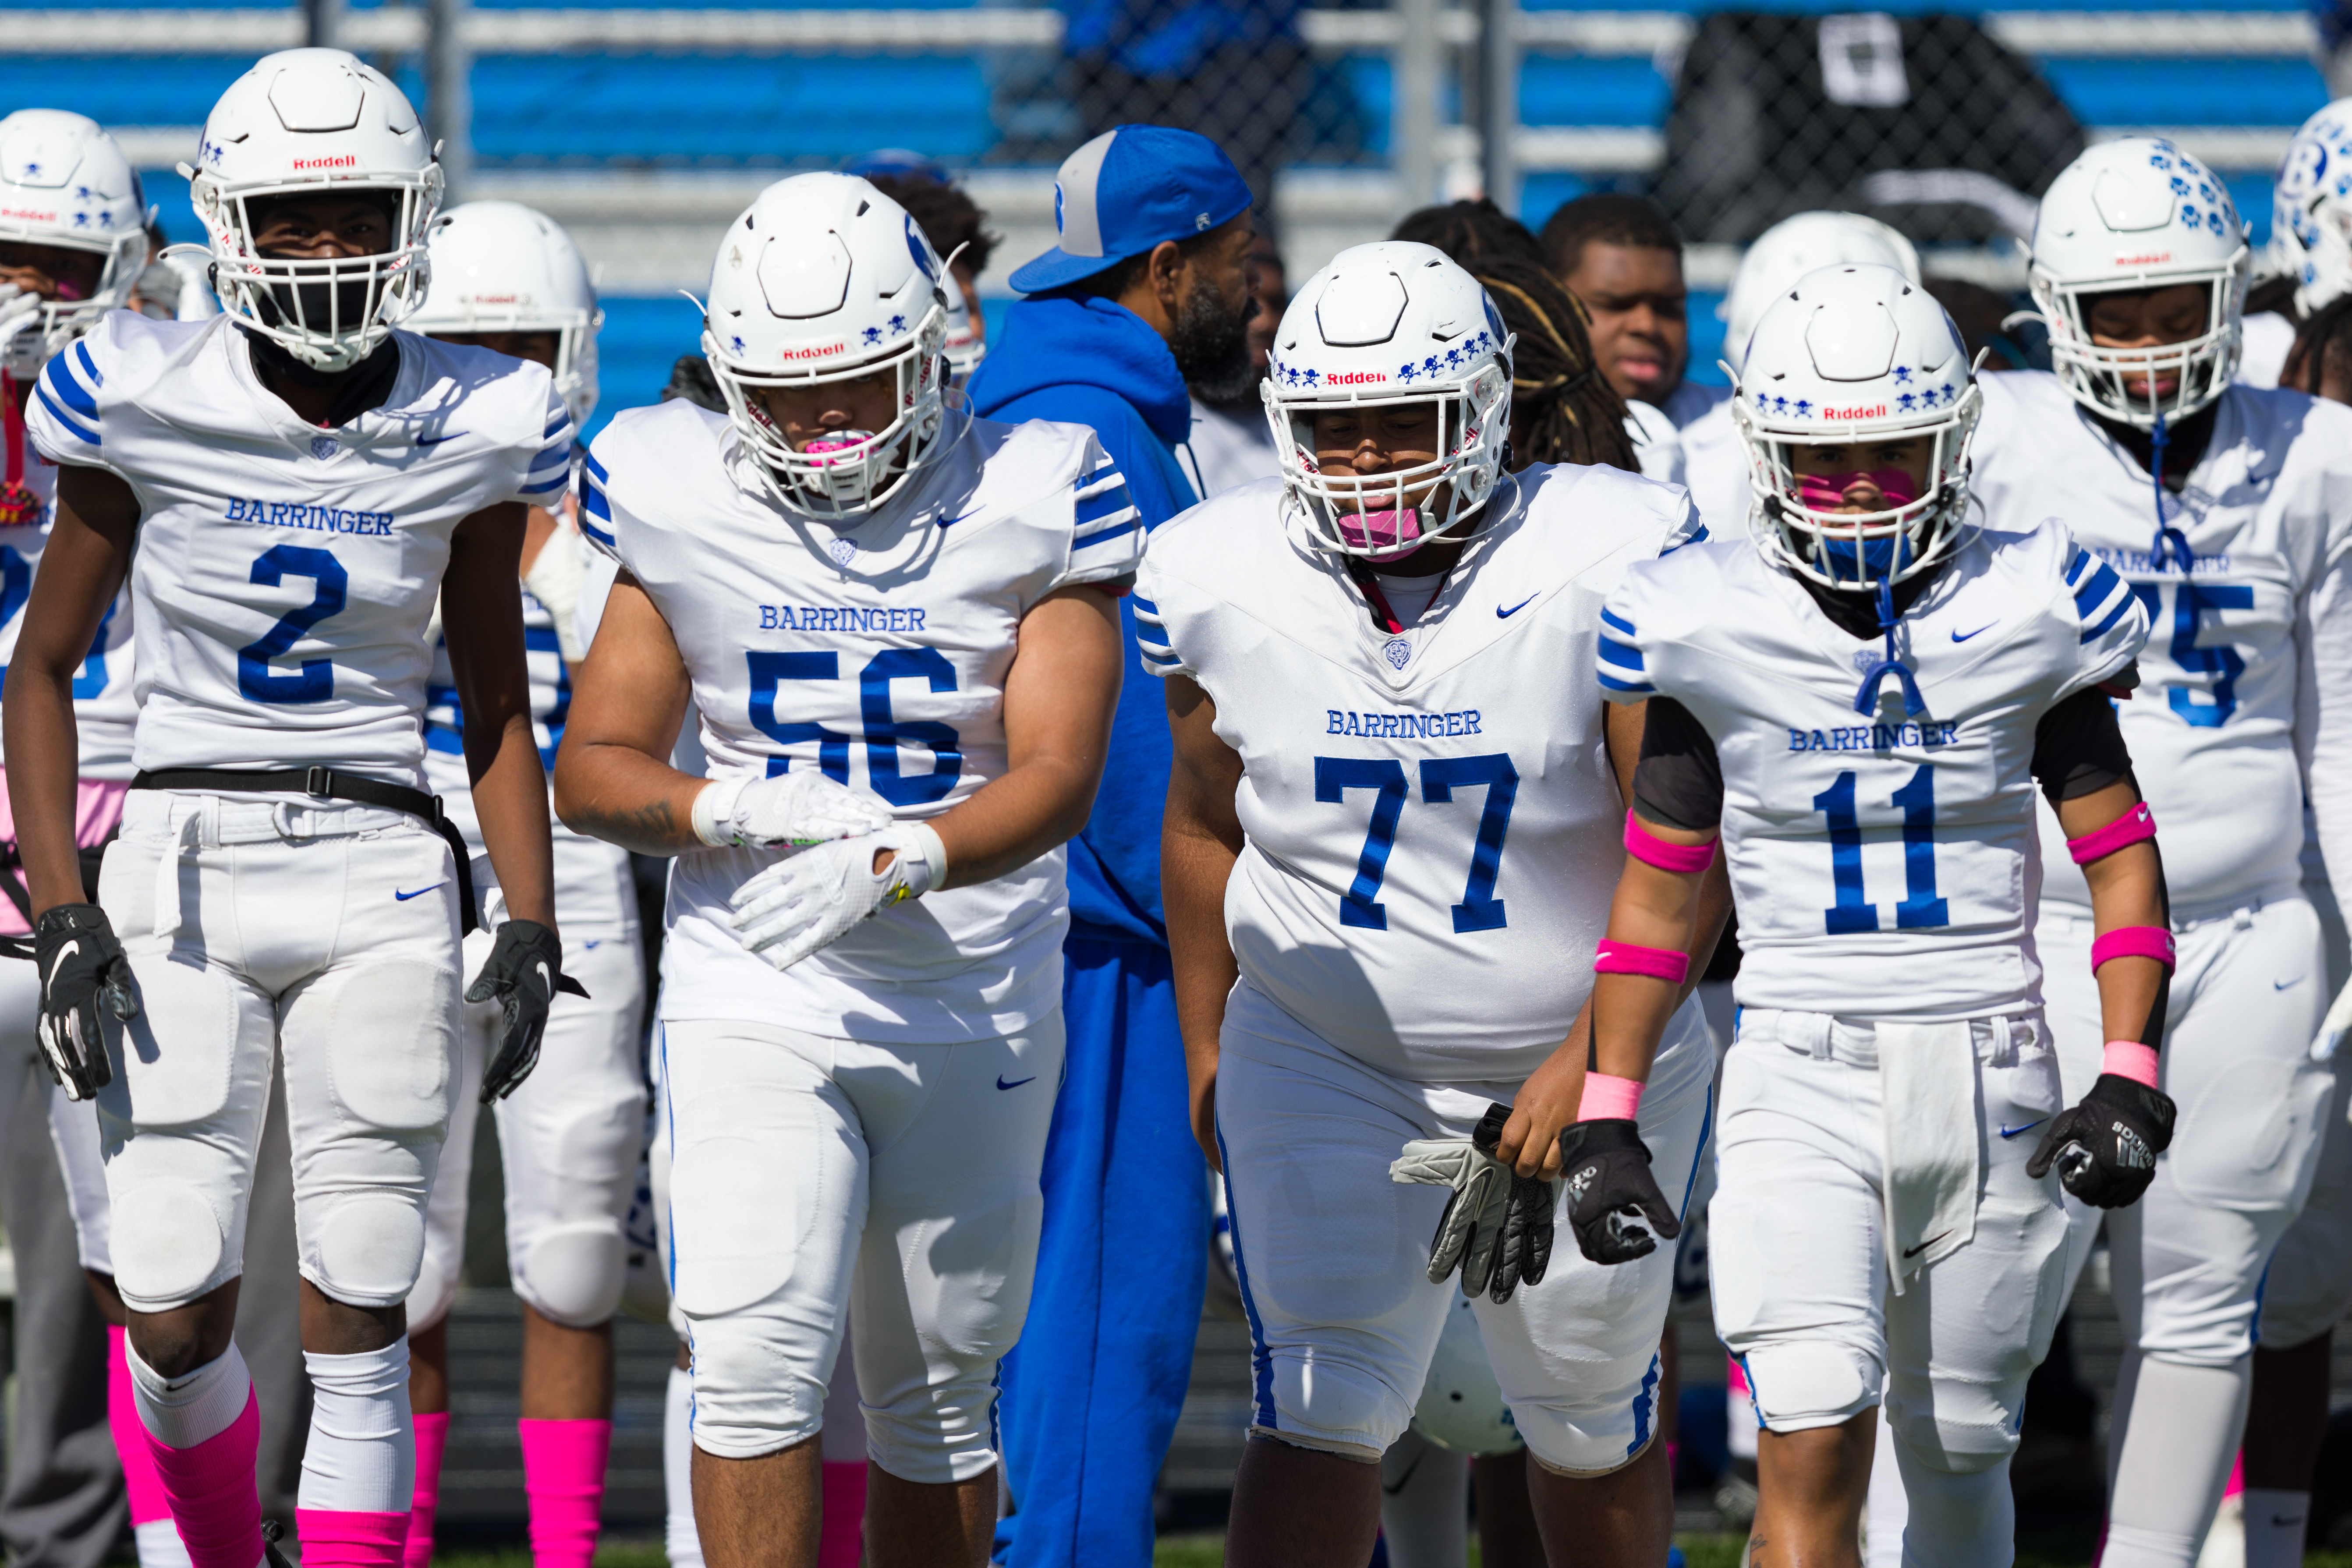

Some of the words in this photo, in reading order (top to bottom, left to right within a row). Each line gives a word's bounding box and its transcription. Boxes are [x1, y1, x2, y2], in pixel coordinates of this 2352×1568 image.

[294, 155, 355, 170] Riddell
[1327, 372, 1386, 385] Riddell
[1824, 404, 1886, 420] Riddell
[224, 497, 394, 535] BARRINGER
[237, 544, 348, 704] 2
[759, 605, 926, 632] BARRINGER
[746, 646, 962, 807] 56
[1327, 709, 1482, 739] BARRINGER
[1788, 721, 1959, 751] BARRINGER
[1314, 753, 1519, 934] 77
[1813, 764, 1949, 935] 11
